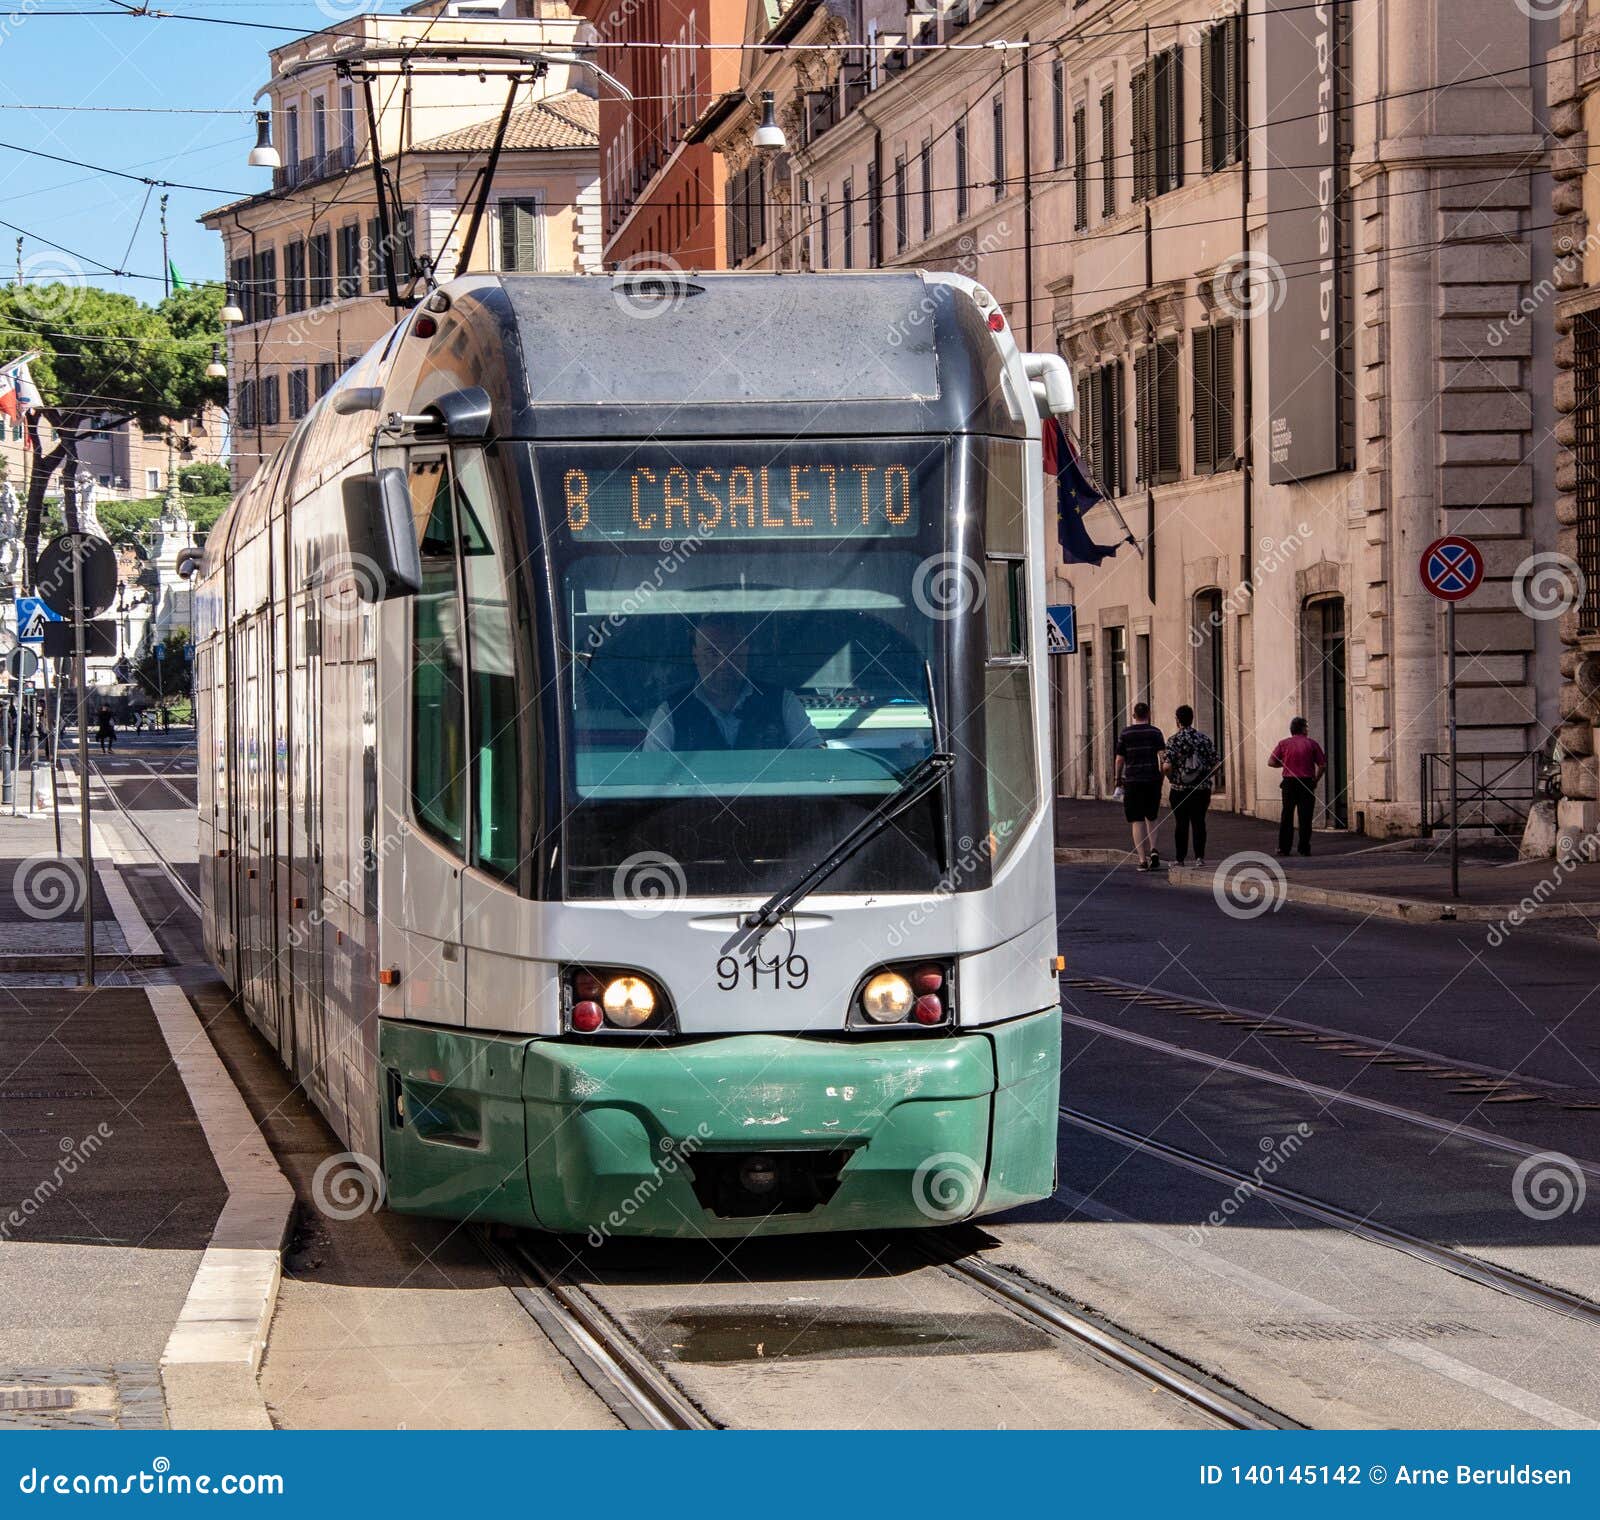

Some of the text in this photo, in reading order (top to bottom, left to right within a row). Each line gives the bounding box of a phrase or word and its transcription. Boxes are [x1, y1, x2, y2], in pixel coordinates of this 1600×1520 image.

[1319, 167, 1333, 341] balbi
[631, 463, 910, 529] CASALETTO
[716, 954, 809, 991] 9119
